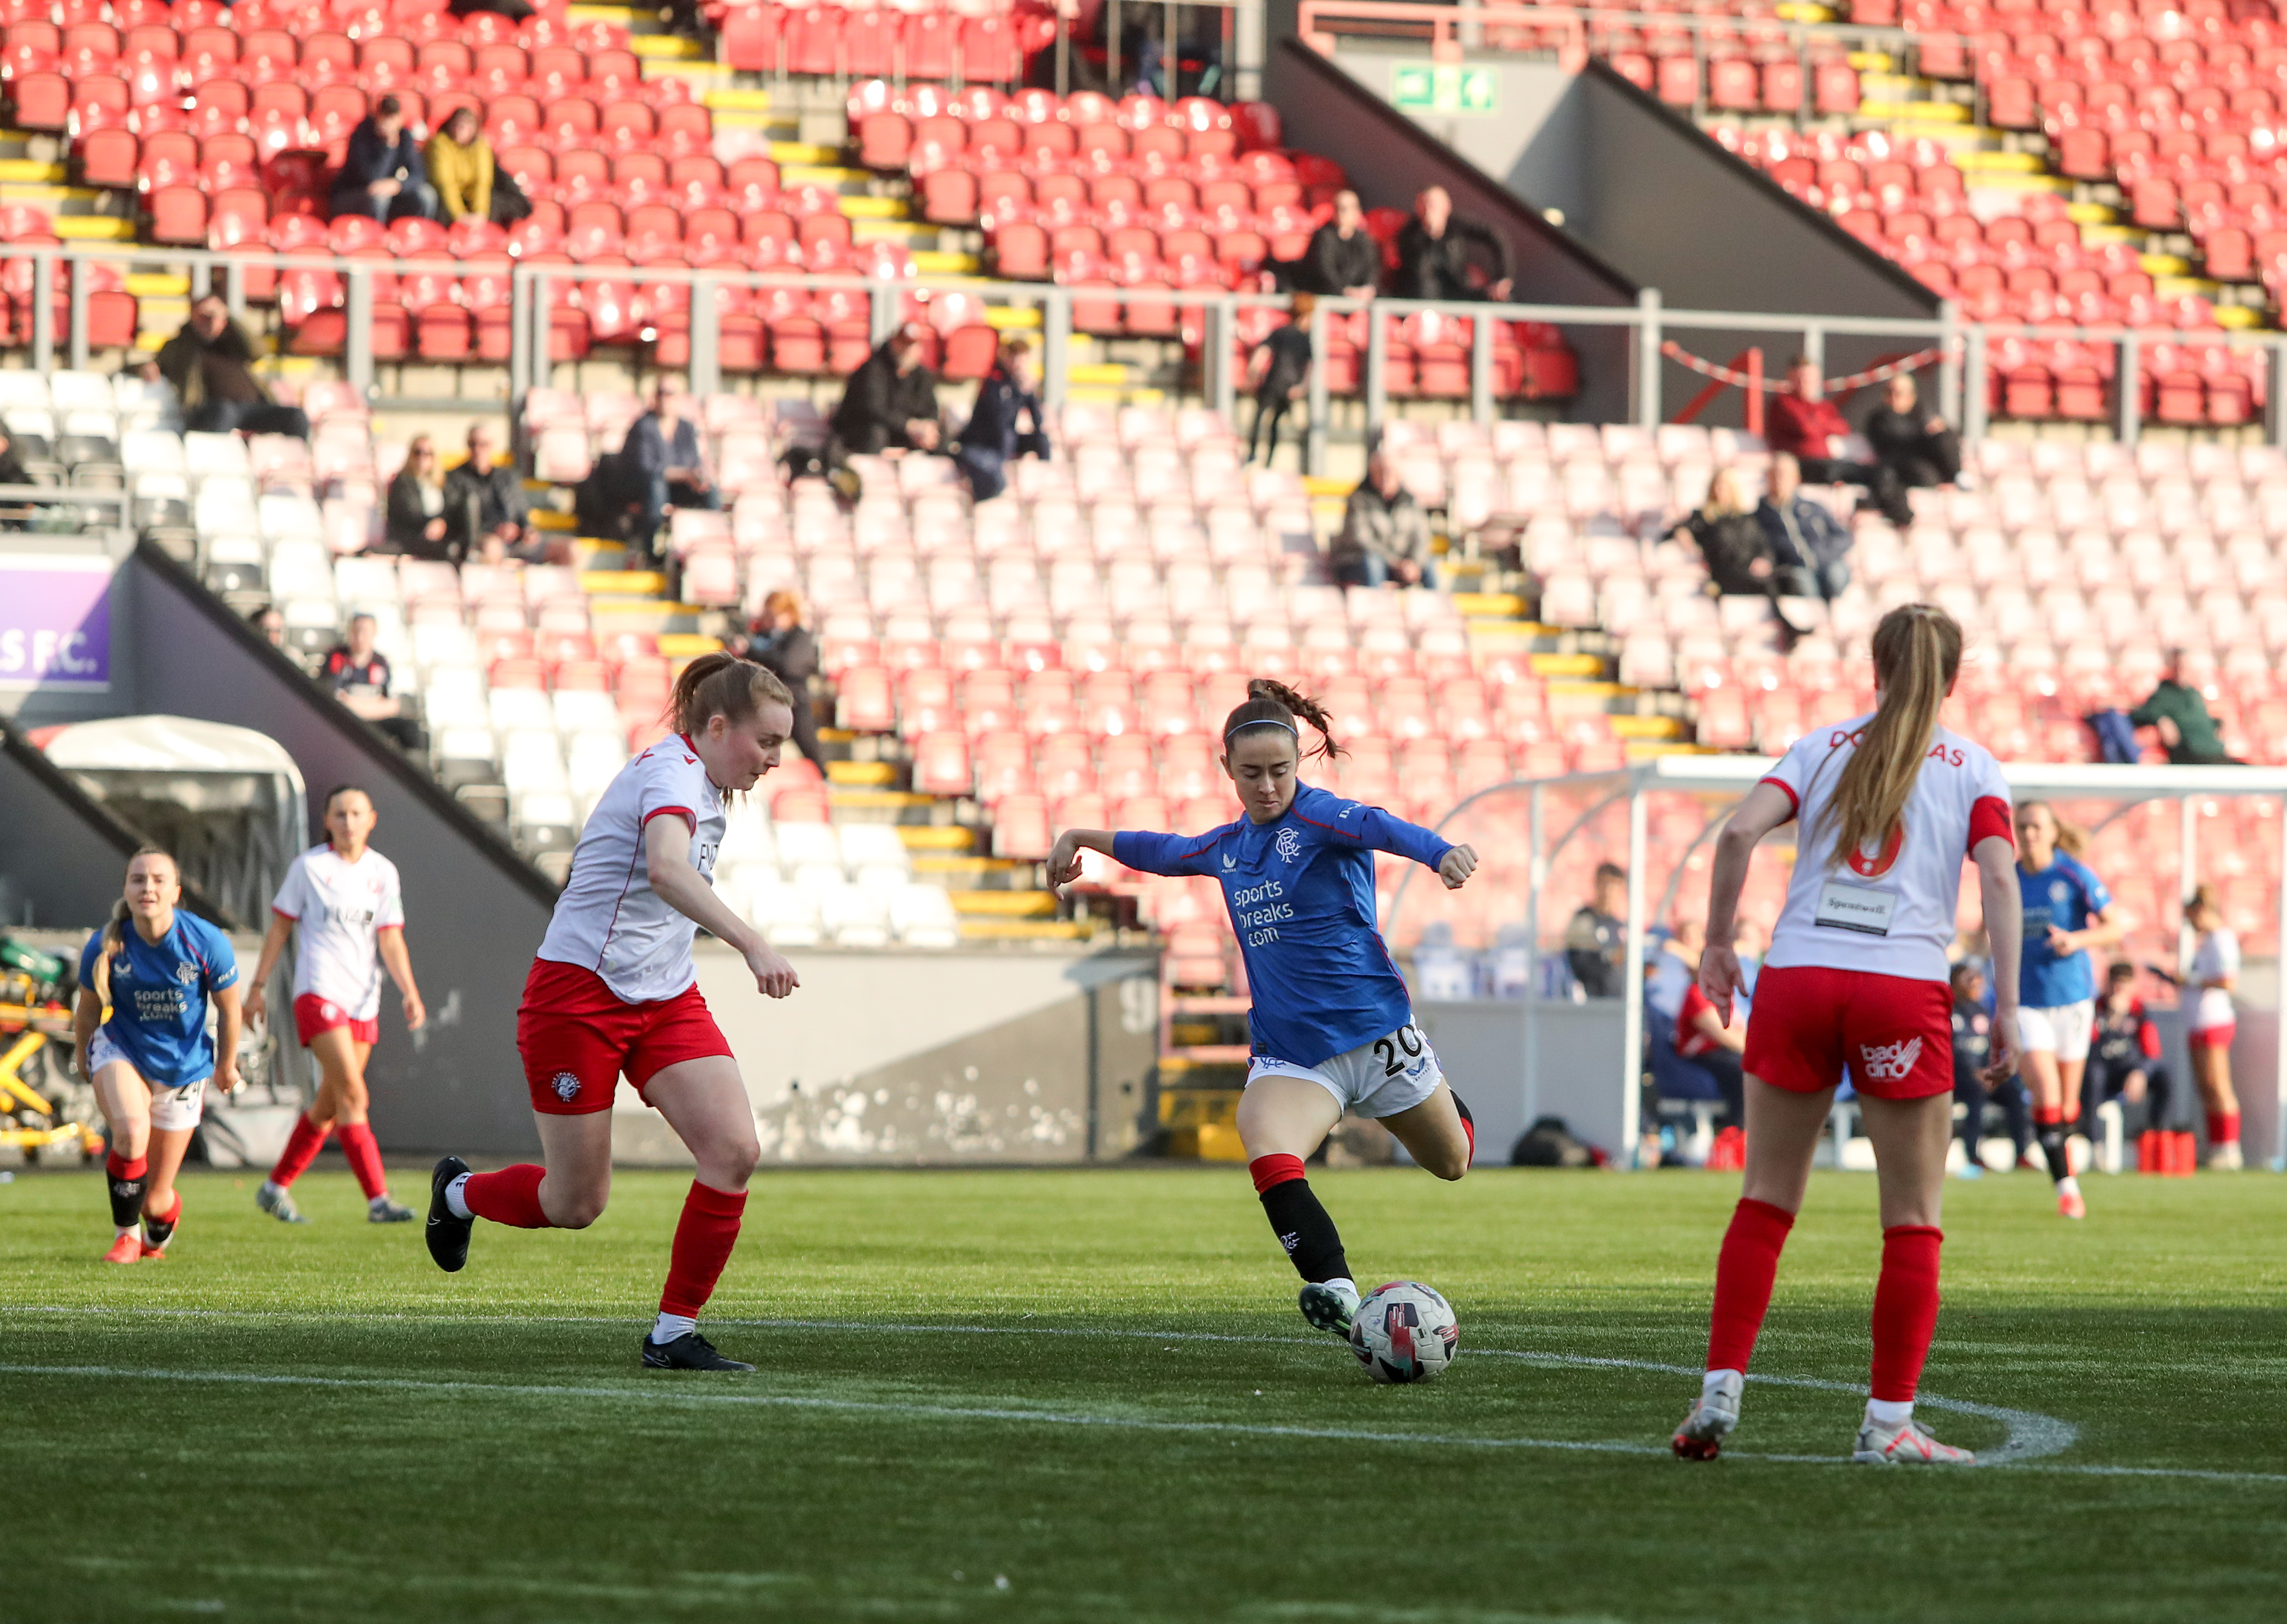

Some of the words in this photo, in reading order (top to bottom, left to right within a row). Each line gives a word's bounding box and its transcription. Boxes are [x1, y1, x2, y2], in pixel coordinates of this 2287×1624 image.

[1830, 729, 1966, 766] DOAS
[1234, 880, 1282, 907] sports
[1238, 902, 1294, 928] breaks
[1373, 1024, 1422, 1078] 20
